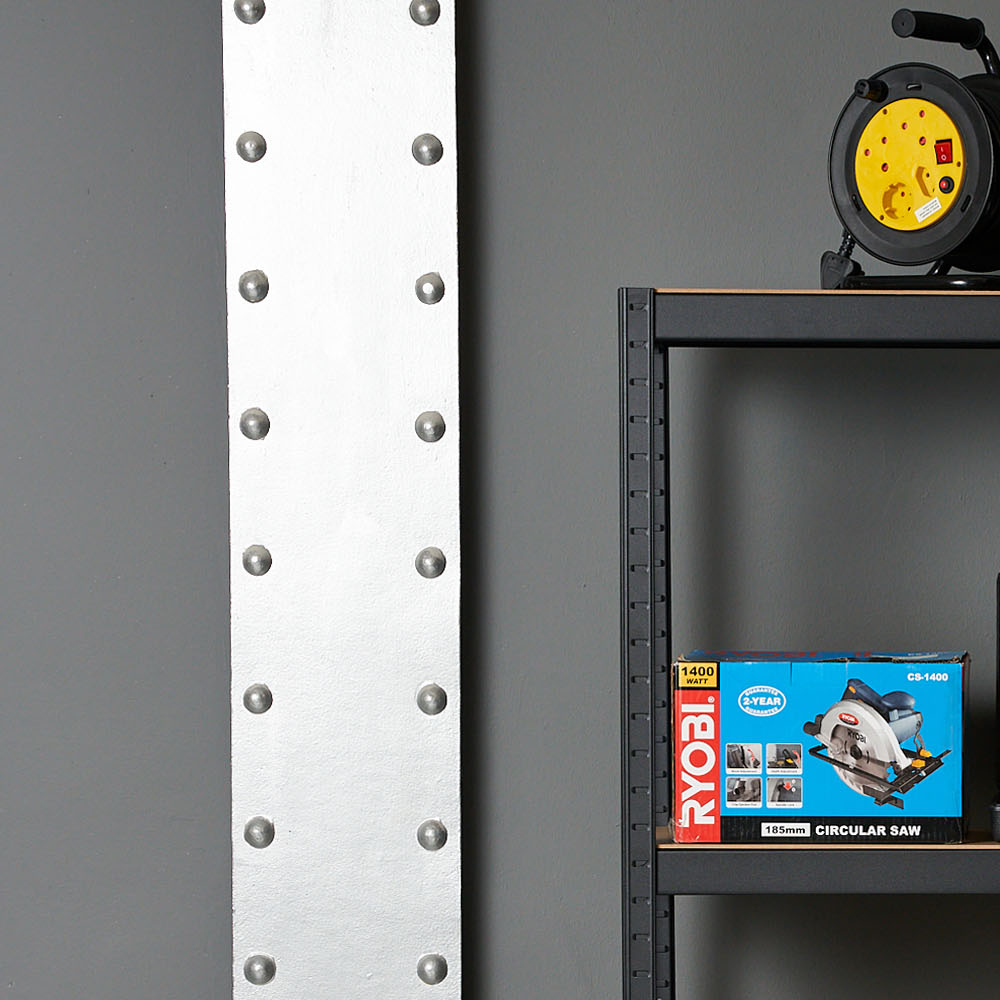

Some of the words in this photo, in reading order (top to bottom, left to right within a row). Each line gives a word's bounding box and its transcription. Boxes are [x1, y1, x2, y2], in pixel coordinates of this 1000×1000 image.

[681, 666, 715, 677] 1400
[907, 672, 949, 682] CS-1400
[743, 697, 781, 706] 2-YEAR
[680, 703, 716, 828] RYOBI
[765, 825, 806, 835] 185mm
[815, 825, 887, 836] CIRCULAR
[889, 825, 922, 836] SAW
